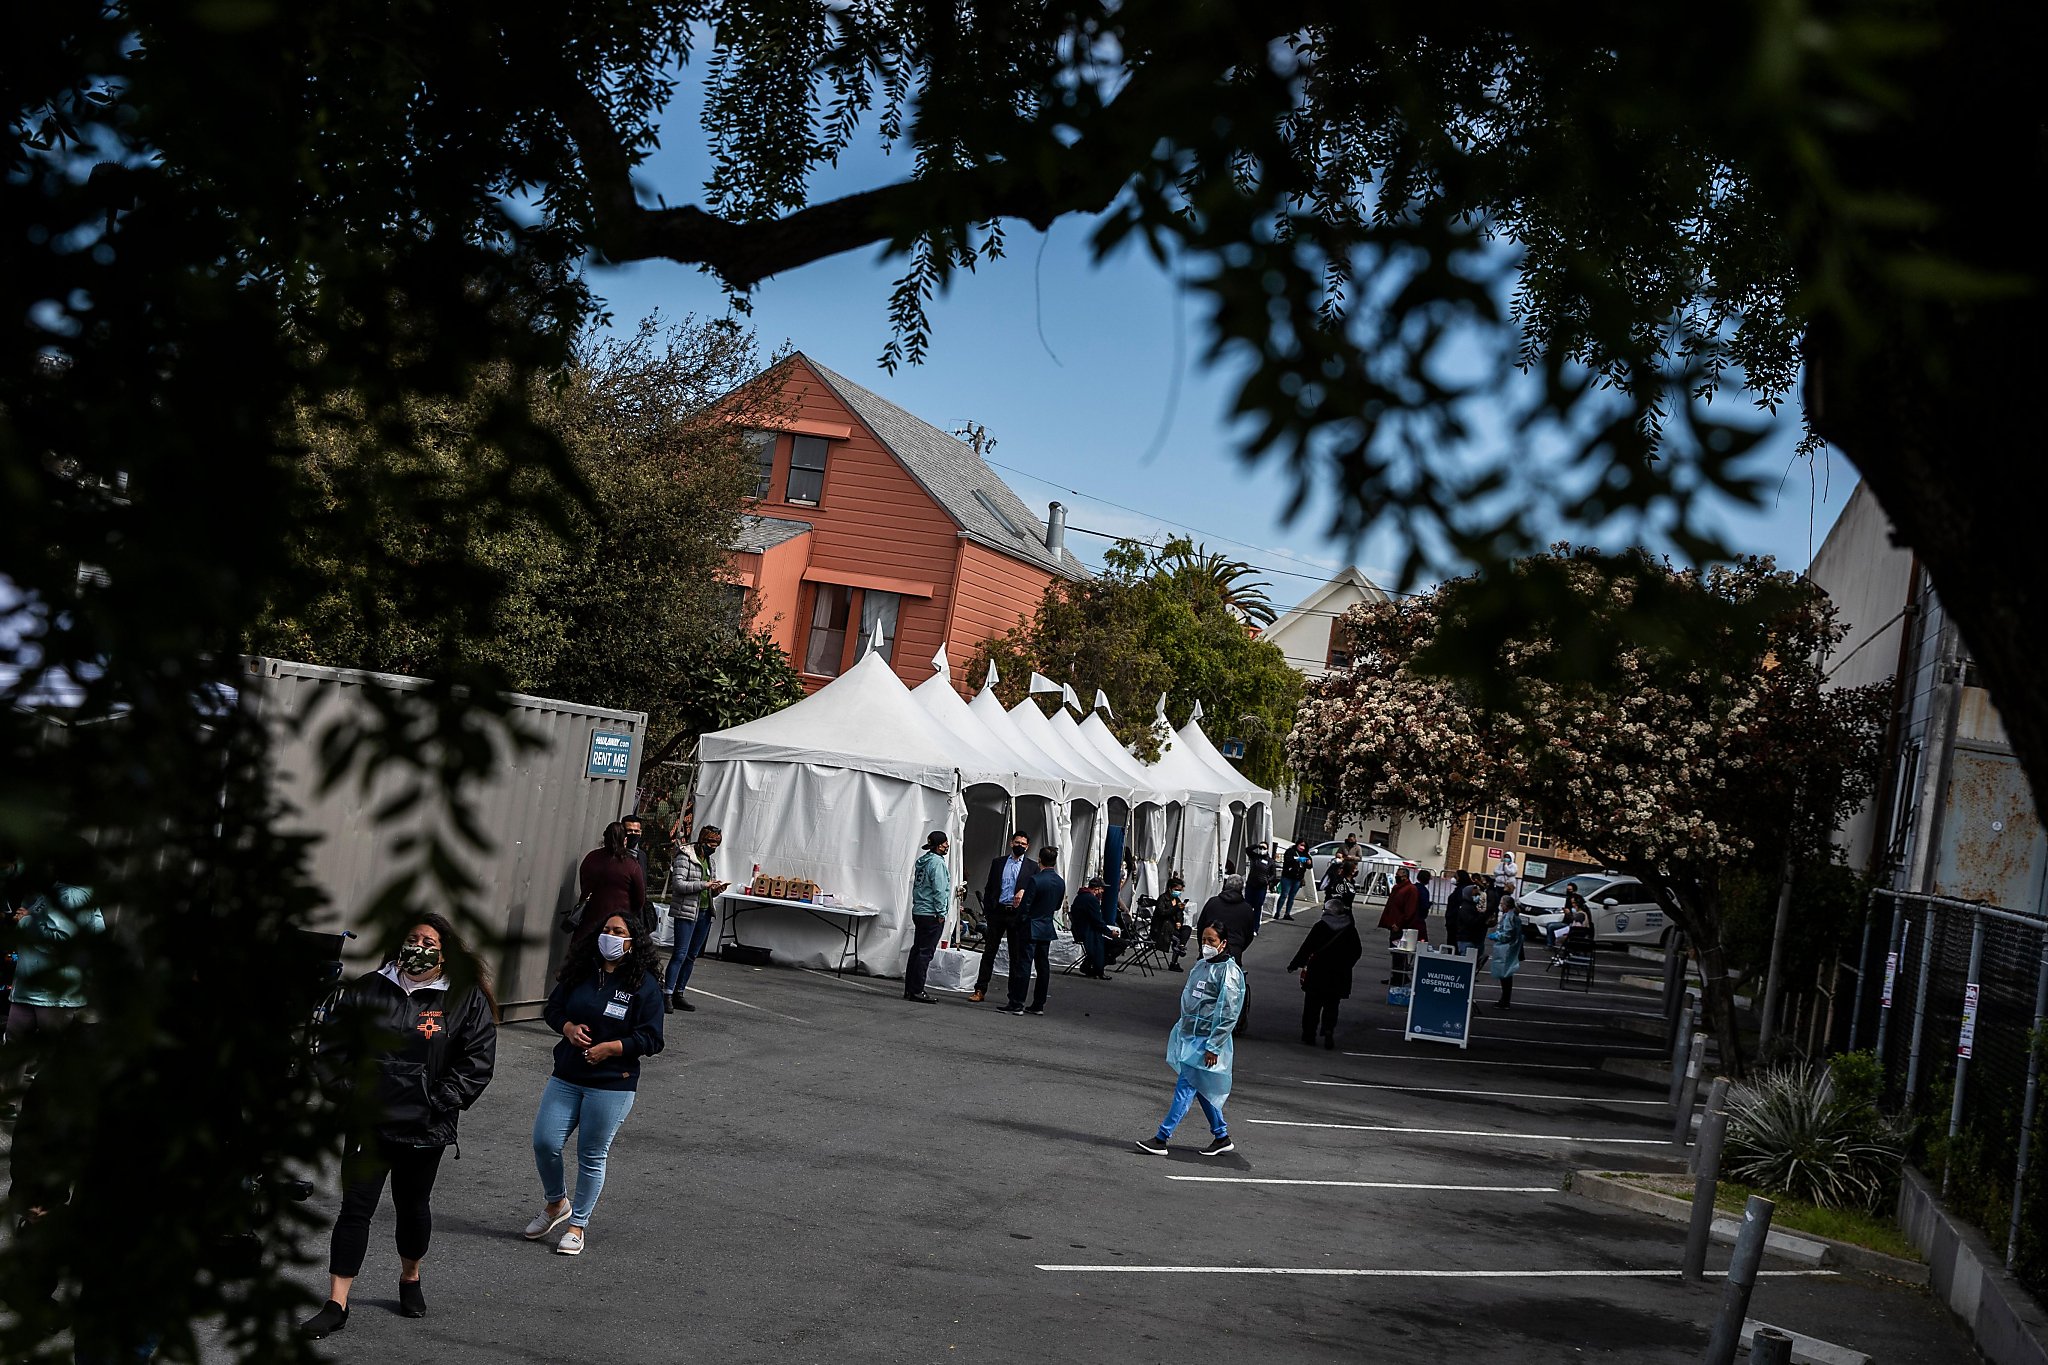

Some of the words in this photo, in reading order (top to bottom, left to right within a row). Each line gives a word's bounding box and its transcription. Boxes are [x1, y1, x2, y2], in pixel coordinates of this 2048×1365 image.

[592, 751, 613, 767] RENT
[612, 752, 628, 768] ME!
[1427, 971, 1455, 982] WAITING
[1421, 978, 1465, 990] OBSERVATION
[1433, 986, 1451, 995] AREA
